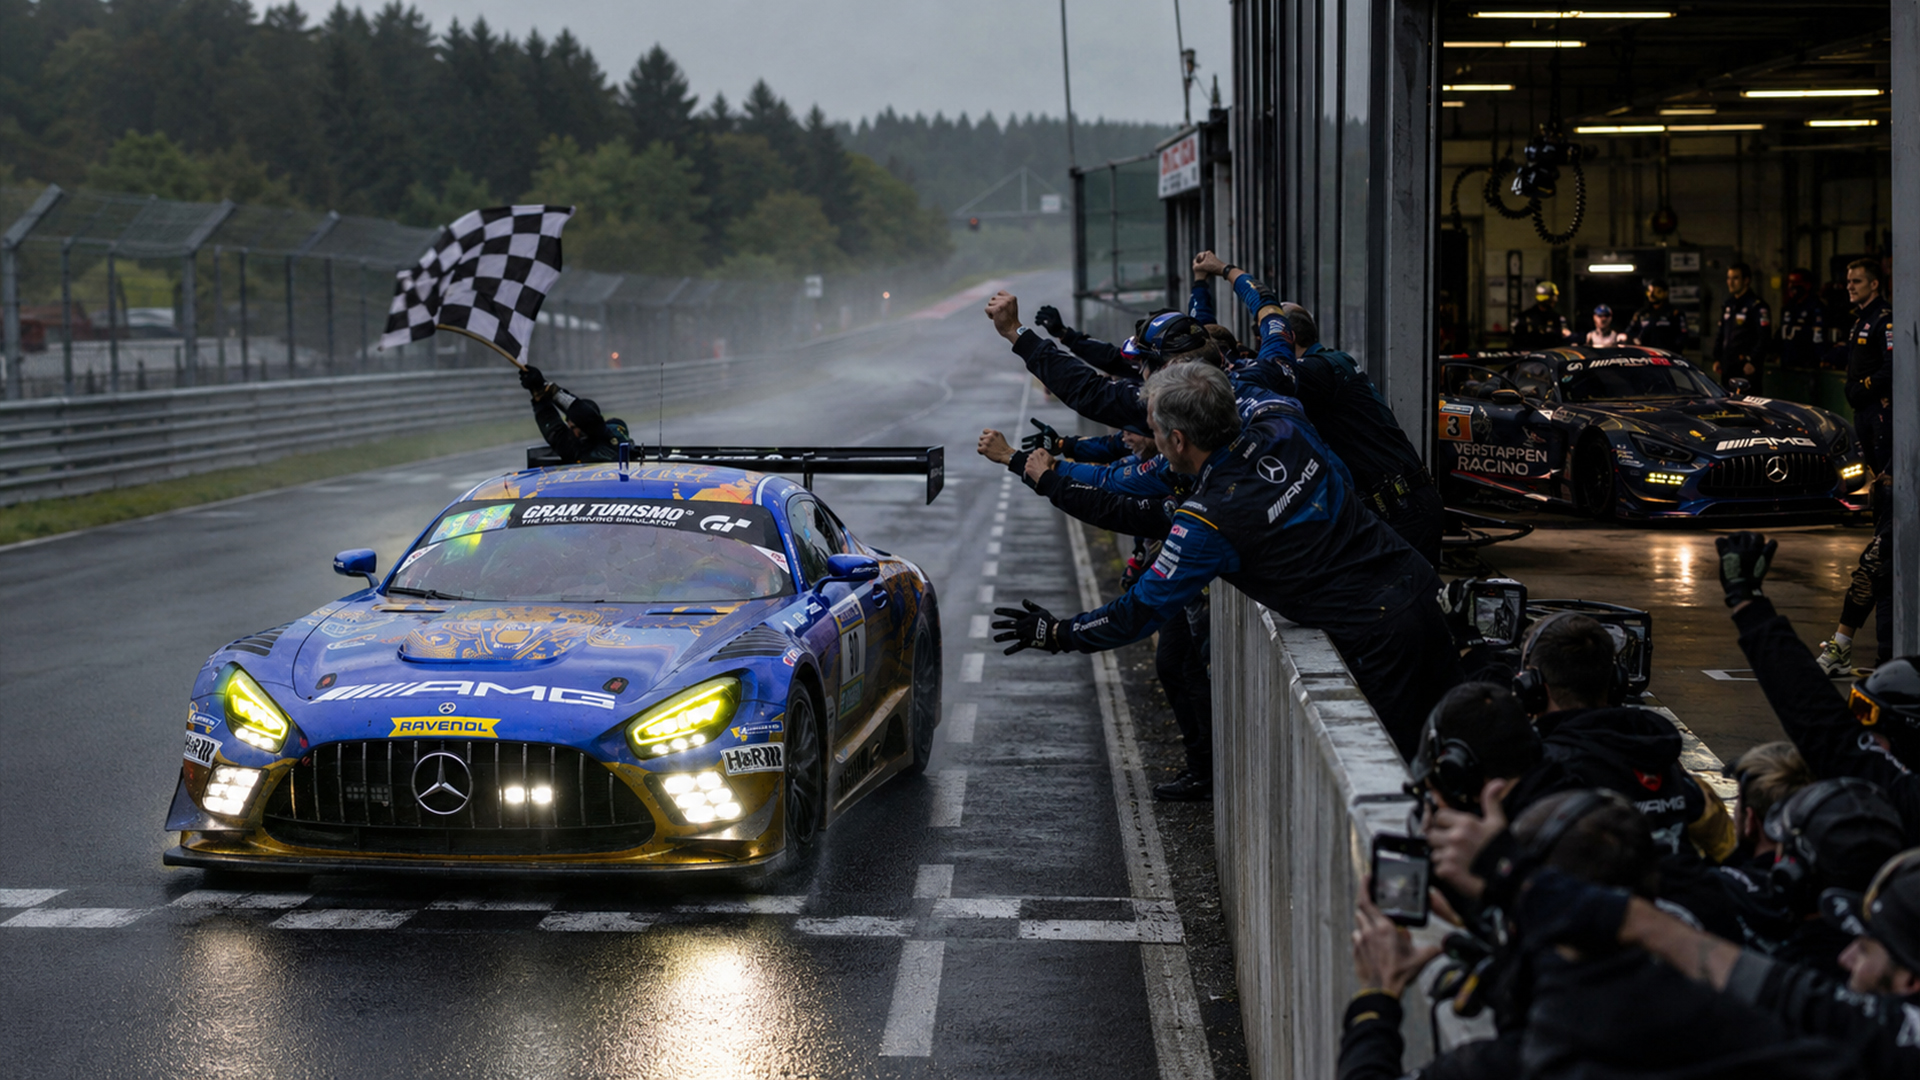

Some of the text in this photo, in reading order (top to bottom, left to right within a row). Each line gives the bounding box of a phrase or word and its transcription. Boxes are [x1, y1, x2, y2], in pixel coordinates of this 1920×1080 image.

[1446, 415, 1461, 437] 3
[1453, 442, 1548, 463] VERSTAPPEN
[522, 503, 685, 521] GRAN TURISMO
[399, 680, 617, 710] AMG
[399, 720, 489, 733] RAVENOL
[1643, 795, 1686, 814] AMG
